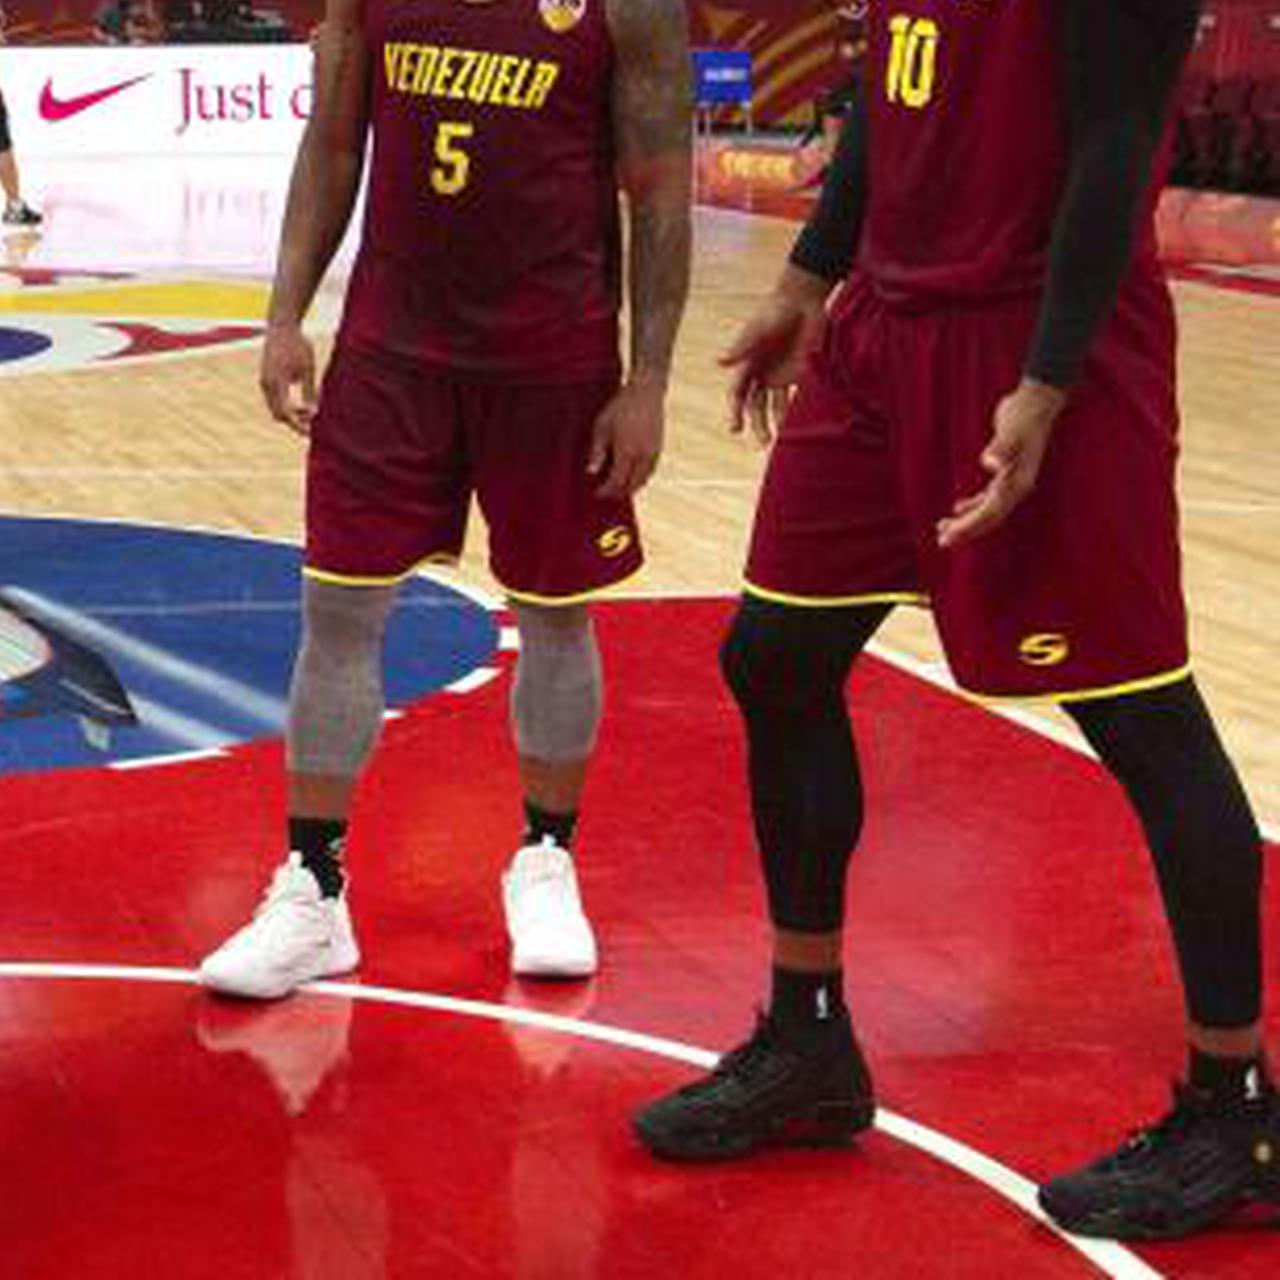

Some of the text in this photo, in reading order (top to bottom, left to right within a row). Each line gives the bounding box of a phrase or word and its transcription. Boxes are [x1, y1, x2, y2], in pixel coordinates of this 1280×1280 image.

[383, 42, 560, 108] VENEZUELA
[886, 14, 939, 108] 10
[176, 67, 274, 135] Just
[431, 121, 474, 195] 5
